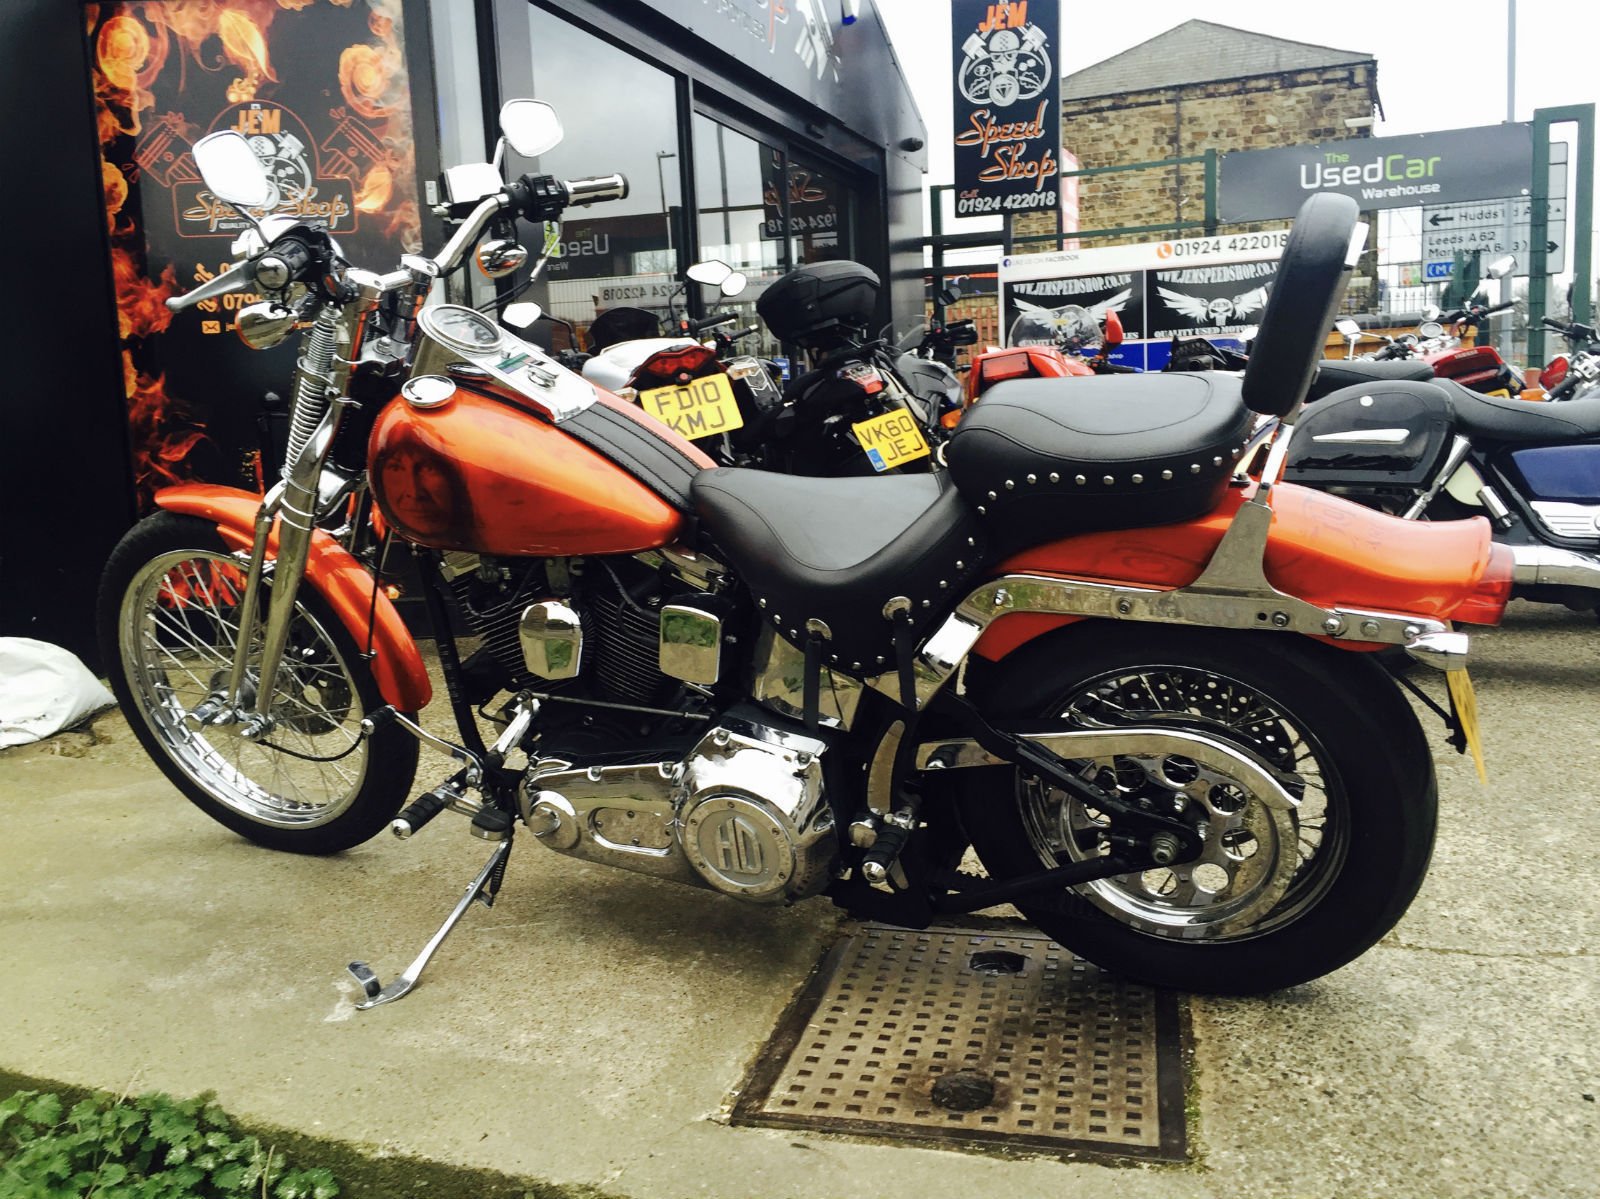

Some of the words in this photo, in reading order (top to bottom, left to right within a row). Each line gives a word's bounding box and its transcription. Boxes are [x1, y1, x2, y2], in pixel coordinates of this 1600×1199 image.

[979, 1, 1028, 32] JEM
[231, 109, 281, 134] JEM
[955, 99, 1049, 158] Speed
[979, 142, 1057, 192] Shop
[1325, 153, 1349, 164] The
[958, 196, 1002, 213] 01924
[1003, 191, 1056, 209] 422018
[1361, 183, 1441, 199] Warehouse
[1174, 240, 1221, 256] 01924
[1229, 234, 1287, 251] 422018
[1428, 234, 1464, 246] Leeds
[1195, 326, 1219, 335] USED
[655, 381, 720, 415] FD10
[666, 406, 725, 436] KMJ
[858, 416, 913, 446] VK60
[888, 434, 923, 460] JEJ
[716, 817, 763, 874] HD
